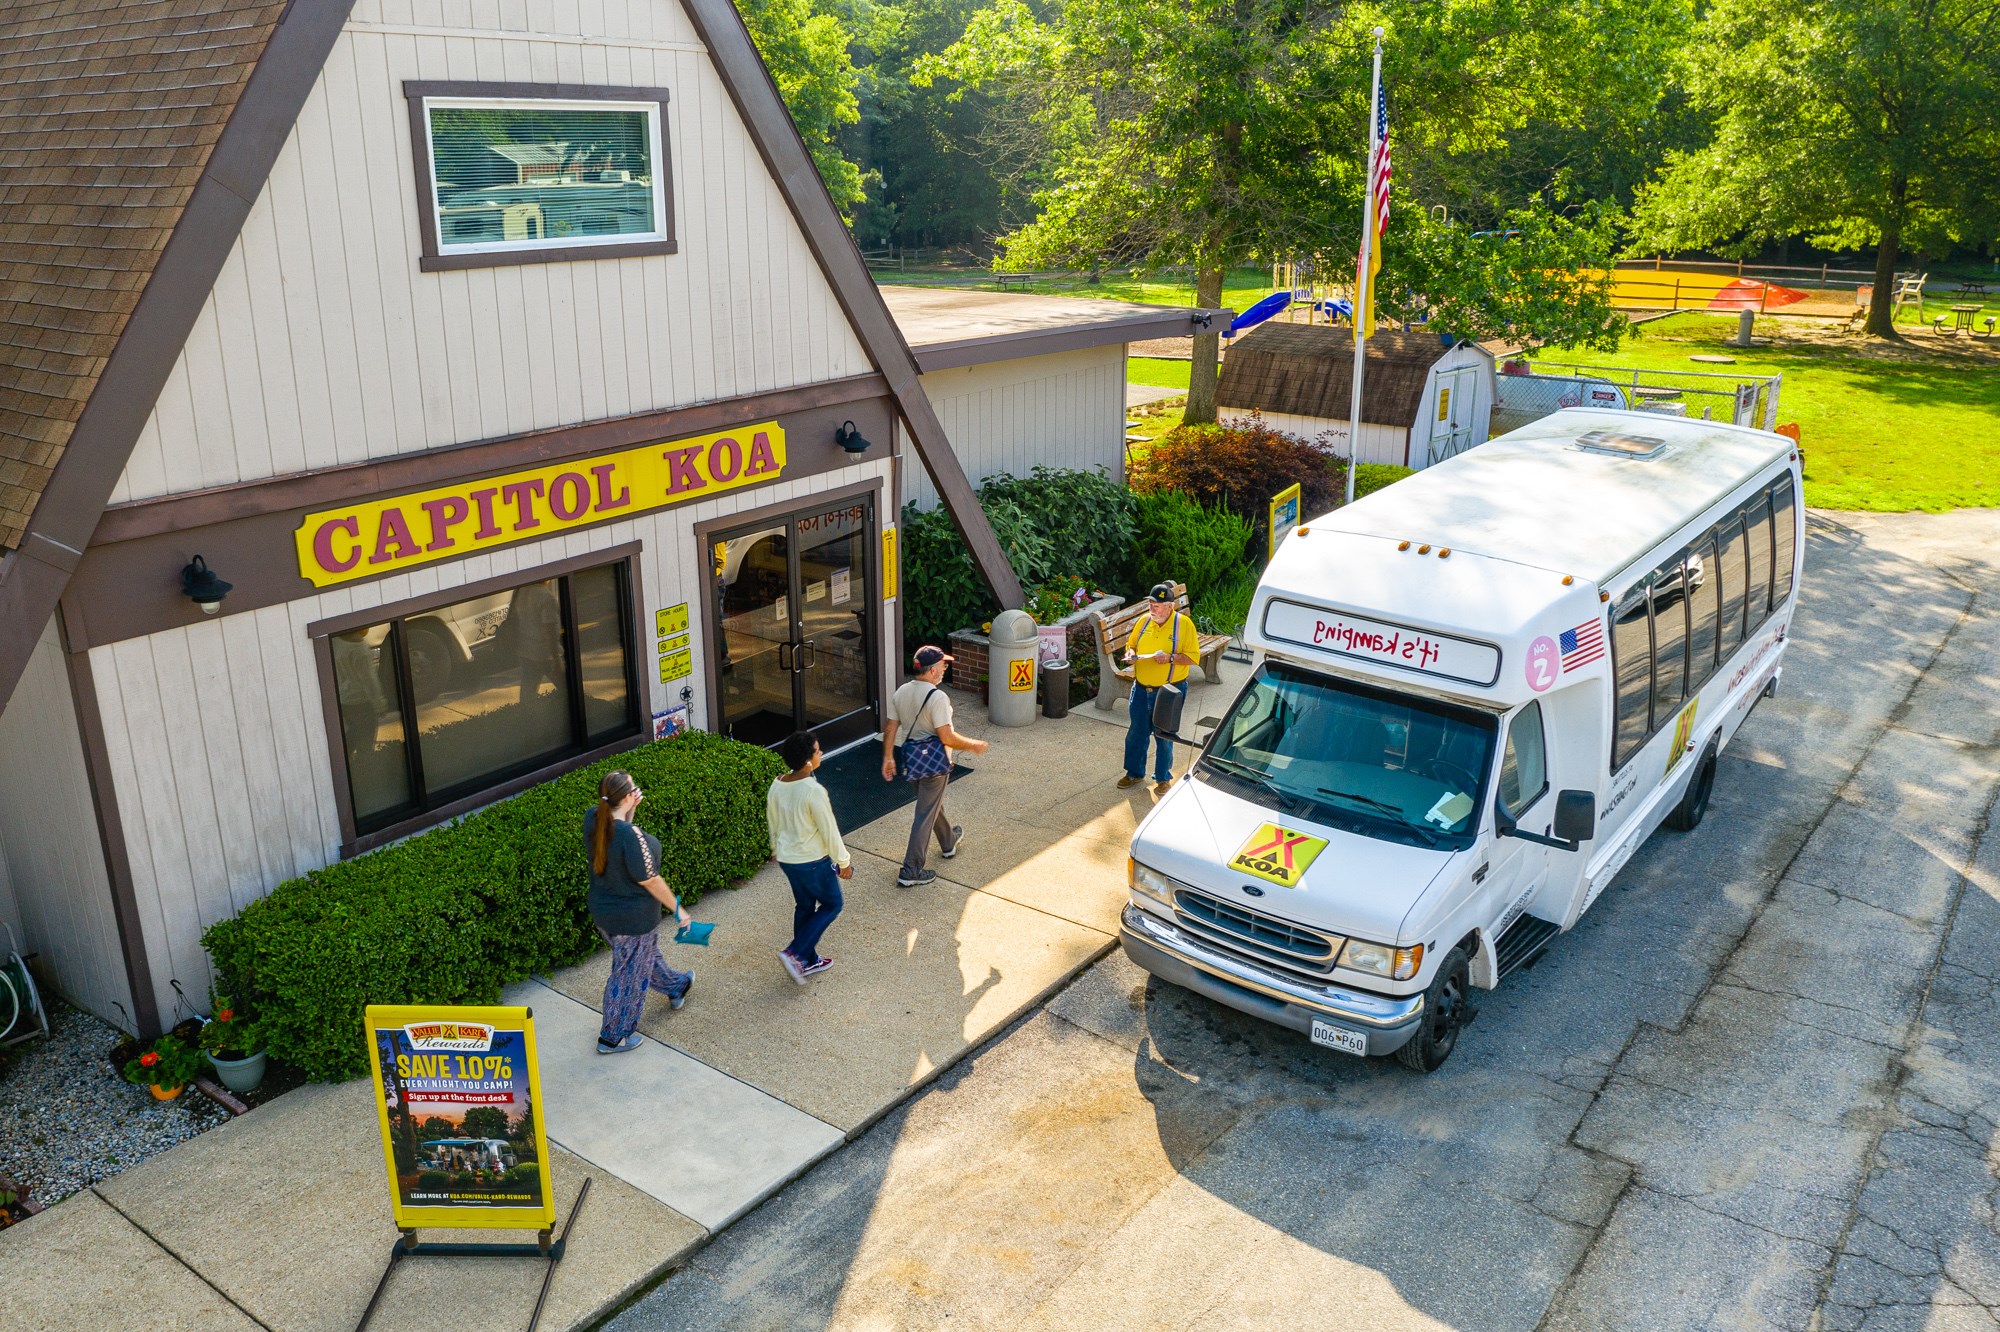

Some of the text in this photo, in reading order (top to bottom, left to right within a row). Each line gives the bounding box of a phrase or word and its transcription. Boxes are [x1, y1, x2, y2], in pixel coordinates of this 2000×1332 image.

[313, 431, 780, 573] CAPITOL KOA
[1533, 658, 1552, 686] 2
[1235, 854, 1289, 880] KOA
[411, 1026, 440, 1037] VALUE
[416, 1036, 486, 1048] Rewards
[396, 1054, 452, 1078] SAVE
[400, 1080, 513, 1090] EVERY NIGHT YOU CAMP!
[466, 1094, 486, 1102] front
